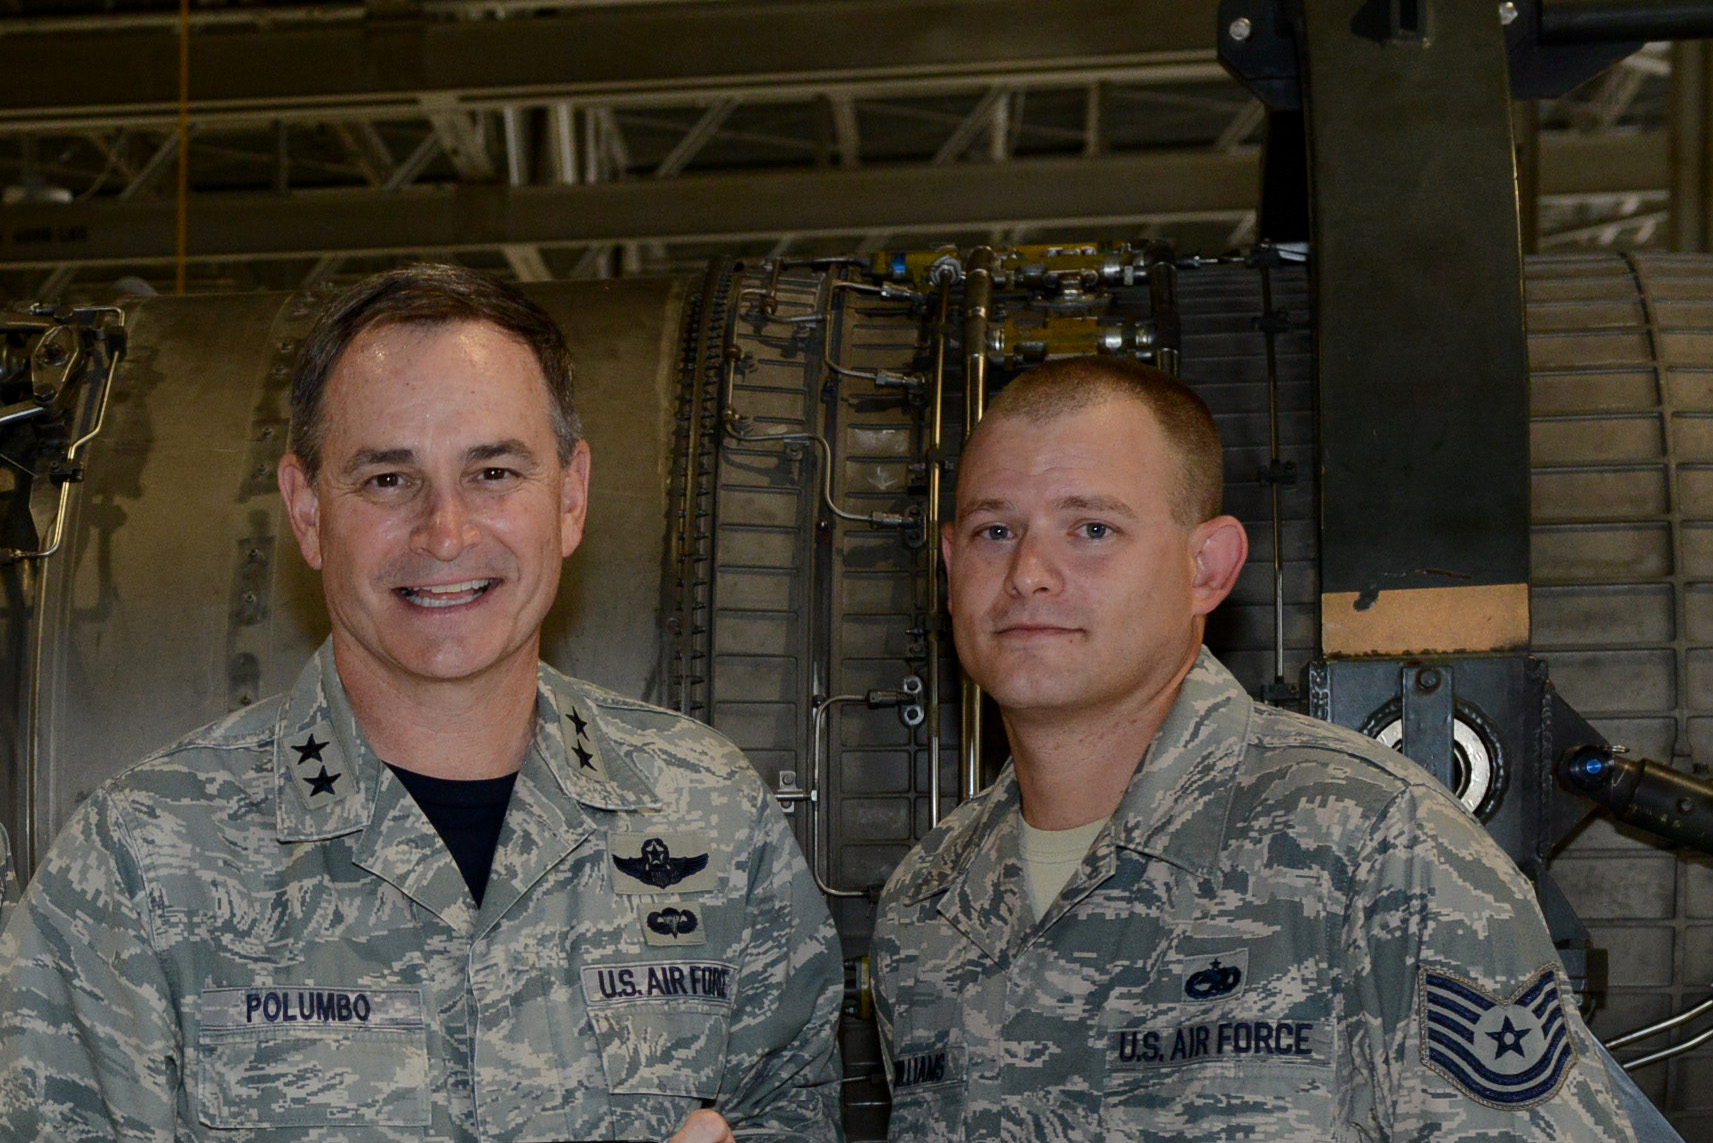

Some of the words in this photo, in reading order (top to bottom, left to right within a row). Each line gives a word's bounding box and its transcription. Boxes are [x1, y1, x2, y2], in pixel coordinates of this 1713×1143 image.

[597, 968, 644, 998] U.S.
[647, 966, 687, 995] AIR
[246, 992, 371, 1023] POLUMBO
[1118, 1031, 1164, 1063] U.S.
[1170, 1025, 1210, 1061] AIR
[1216, 1021, 1314, 1055] FORCE
